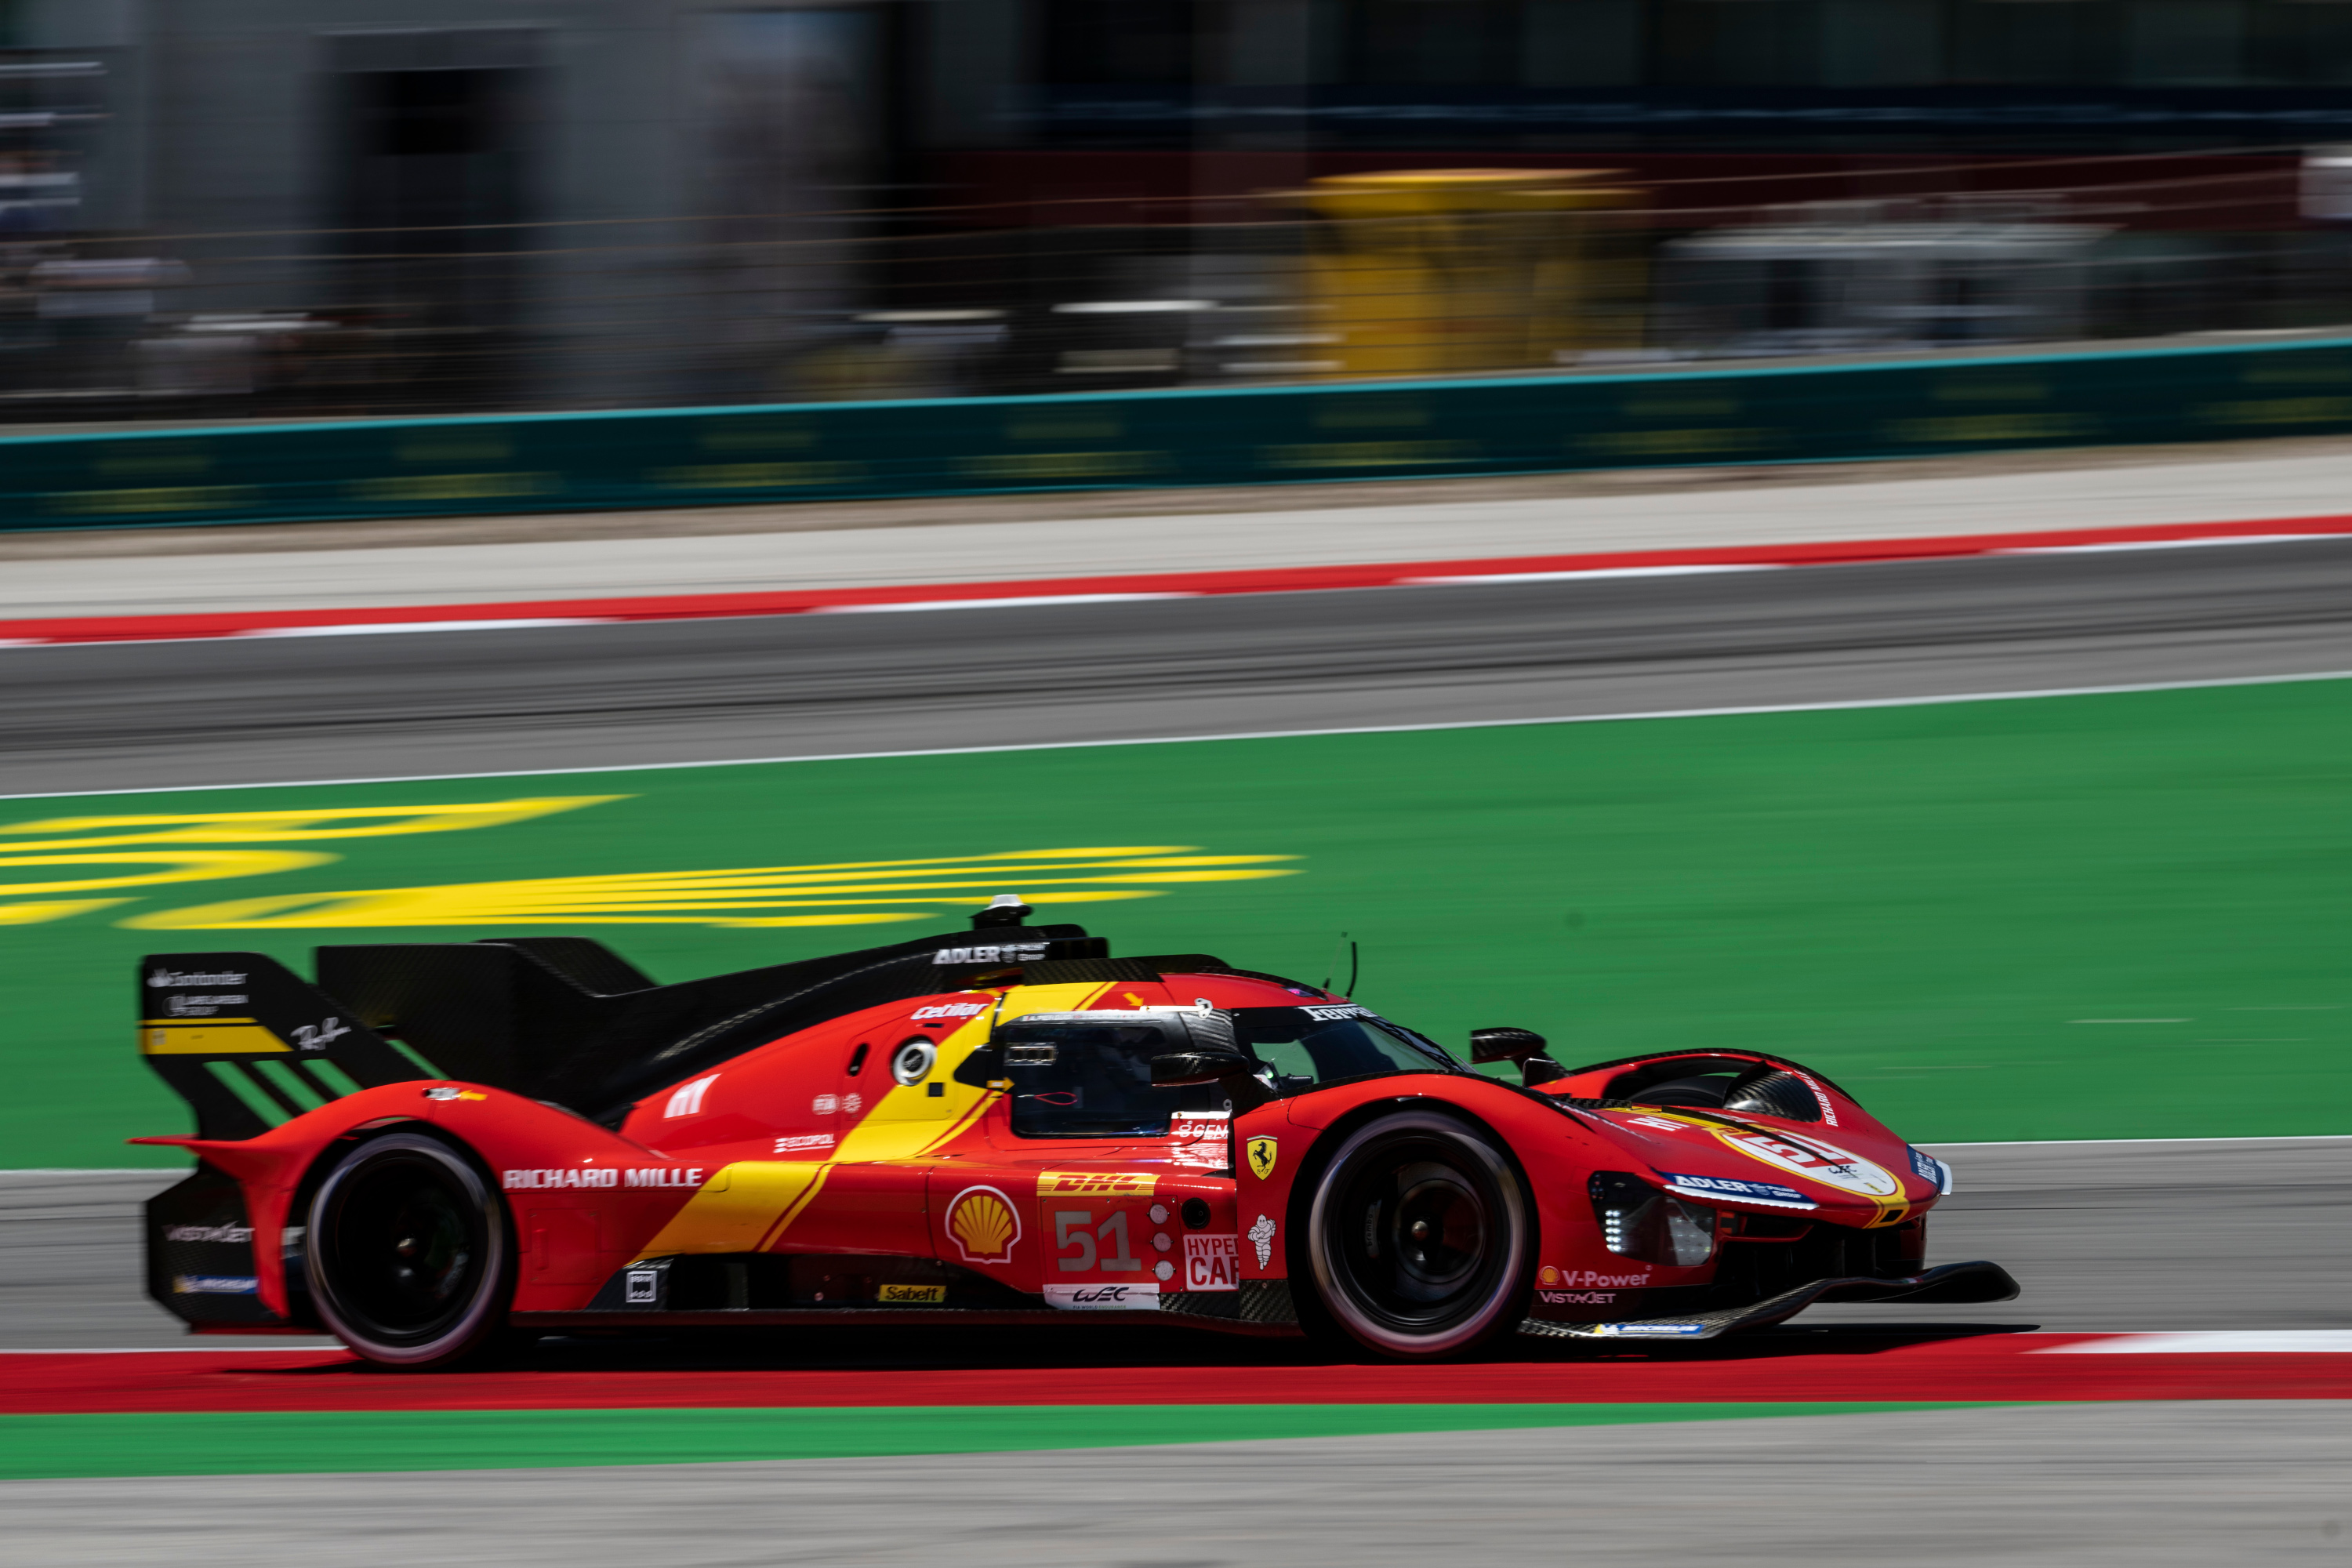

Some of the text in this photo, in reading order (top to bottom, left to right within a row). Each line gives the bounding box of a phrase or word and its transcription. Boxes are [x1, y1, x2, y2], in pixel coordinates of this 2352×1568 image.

[931, 946, 1001, 964] ADLER
[910, 1003, 989, 1020] Cetilar
[1793, 1069, 1822, 1092] MILLE
[1814, 1091, 1838, 1127] RICHARD
[1742, 1135, 1846, 1163] 51
[503, 1168, 703, 1189] RICHARD MILLE
[1053, 1174, 1140, 1192] DHL
[1674, 1175, 1753, 1192] ADLER
[1054, 1210, 1142, 1272] 51
[1562, 1270, 1650, 1287] V-Power
[885, 1286, 940, 1301] Sabelt
[1073, 1287, 1130, 1302] WEC
